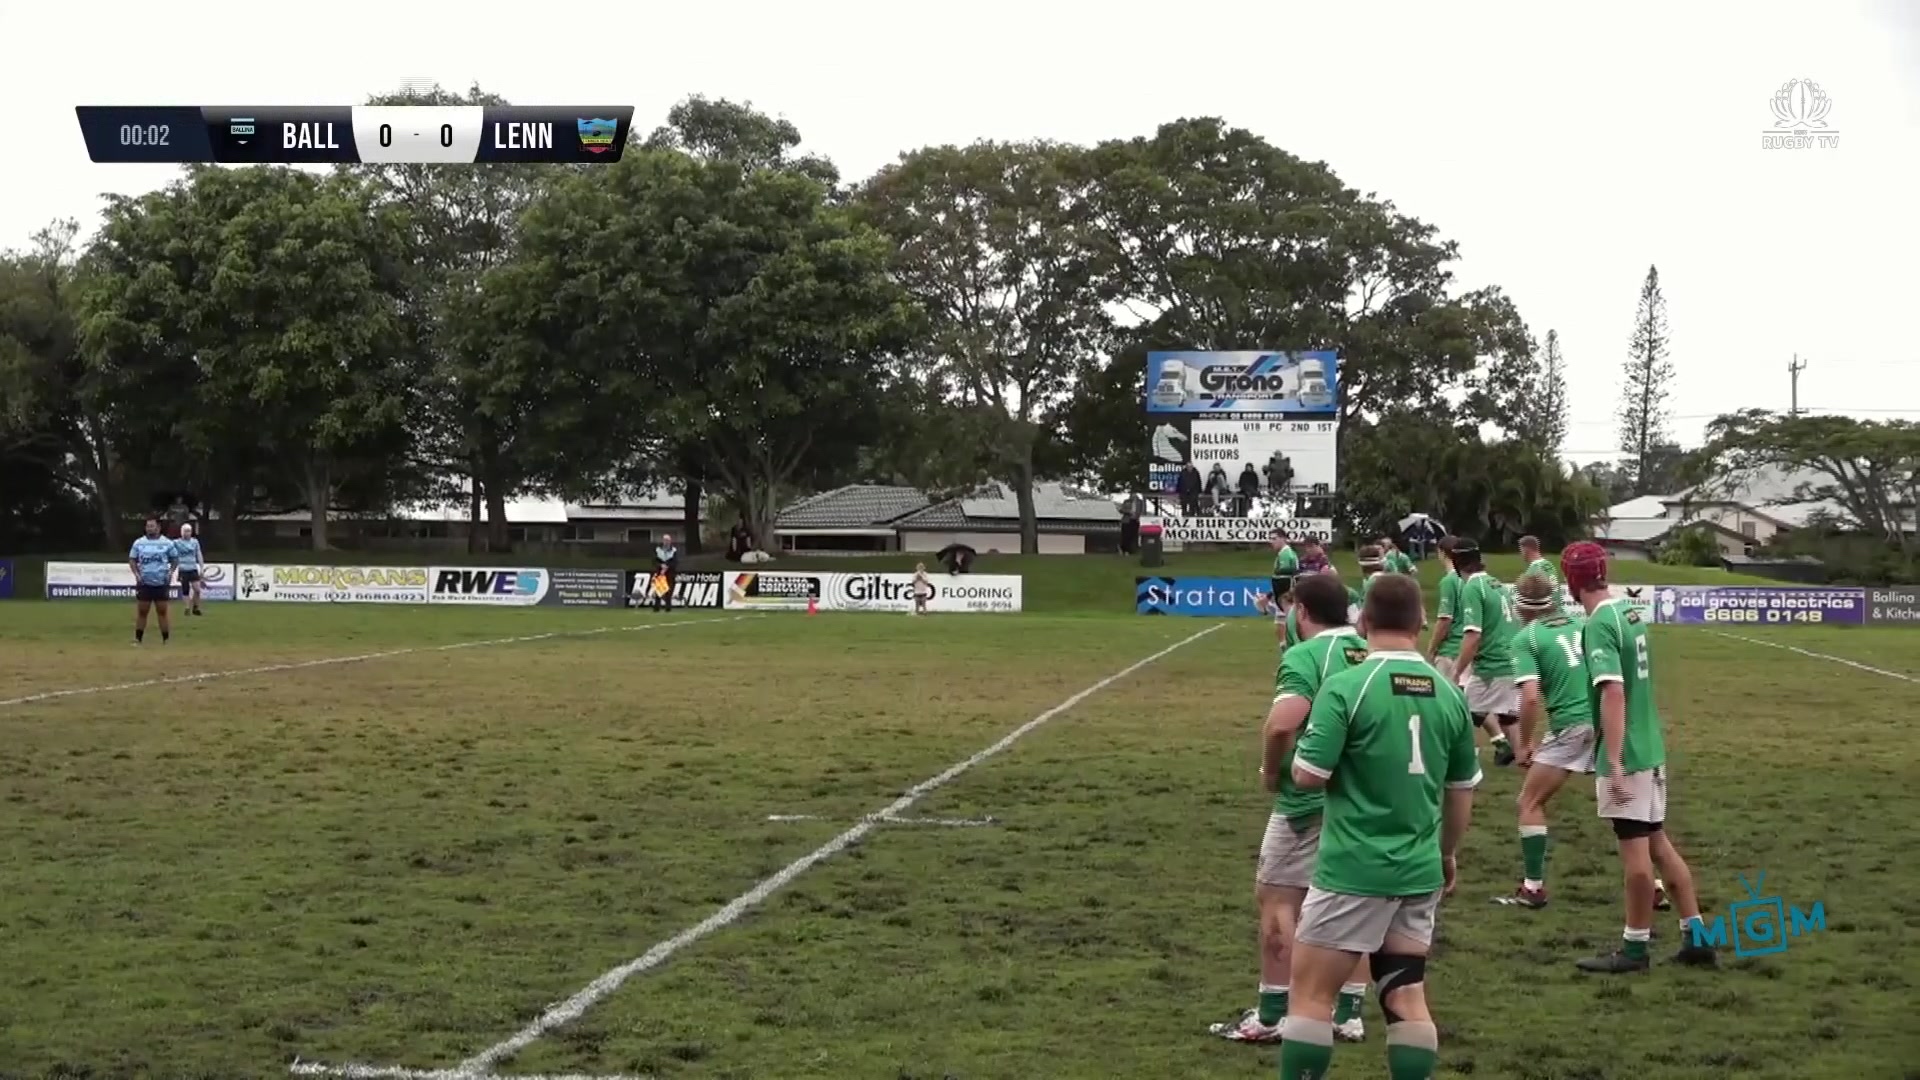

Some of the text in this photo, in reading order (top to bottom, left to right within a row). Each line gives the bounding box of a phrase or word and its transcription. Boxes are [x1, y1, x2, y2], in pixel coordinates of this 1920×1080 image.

[1200, 365, 1284, 391] Grono
[1243, 422, 1332, 432] U18 PC 2ND 1ST
[1193, 434, 1239, 445] BALLINA
[1193, 449, 1240, 460] VISITORS
[1149, 463, 1183, 472] Ballin
[1195, 518, 1311, 529] BURTONWOOD
[1164, 529, 1221, 540] MORIAL
[273, 567, 427, 590] MORGANS
[434, 570, 542, 595] RWES
[942, 587, 1013, 598] FLOORING
[1147, 584, 1235, 606] Strata
[1873, 591, 1915, 603] Ballina
[1681, 594, 1854, 609] col groves electrics
[1767, 610, 1823, 622] 0148
[1872, 607, 1882, 619] &
[1408, 715, 1426, 774] 1
